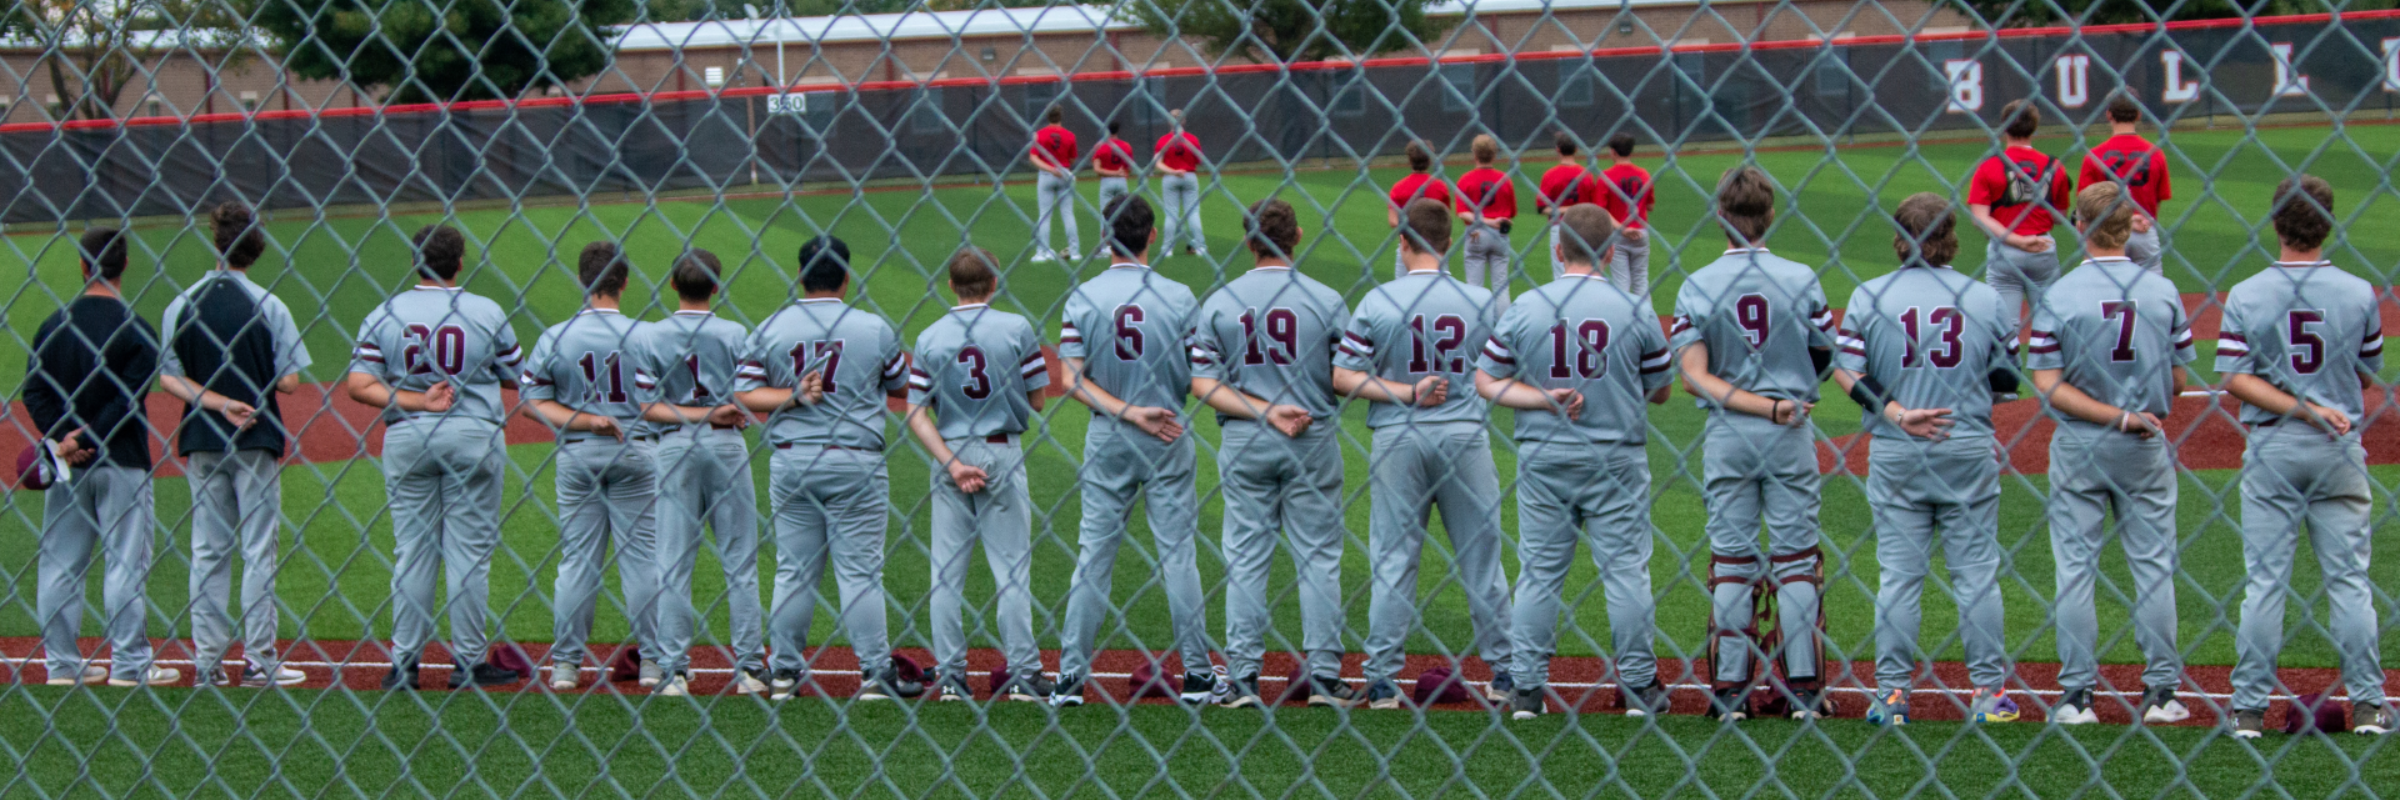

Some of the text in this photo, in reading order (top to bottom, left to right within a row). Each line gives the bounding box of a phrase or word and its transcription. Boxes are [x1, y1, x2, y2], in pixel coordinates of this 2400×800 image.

[403, 322, 466, 376] 20
[1113, 303, 1145, 362] 6
[1239, 306, 1298, 365] 19
[1408, 313, 1467, 375] 12
[1549, 317, 1611, 380] 18
[1736, 292, 1770, 353] 9
[1900, 306, 1965, 368] 13
[2100, 299, 2138, 363] 7
[2289, 309, 2325, 375] 5
[577, 351, 627, 403] 11
[685, 352, 710, 400] 1
[787, 338, 845, 394] 17
[958, 344, 992, 400] 3
